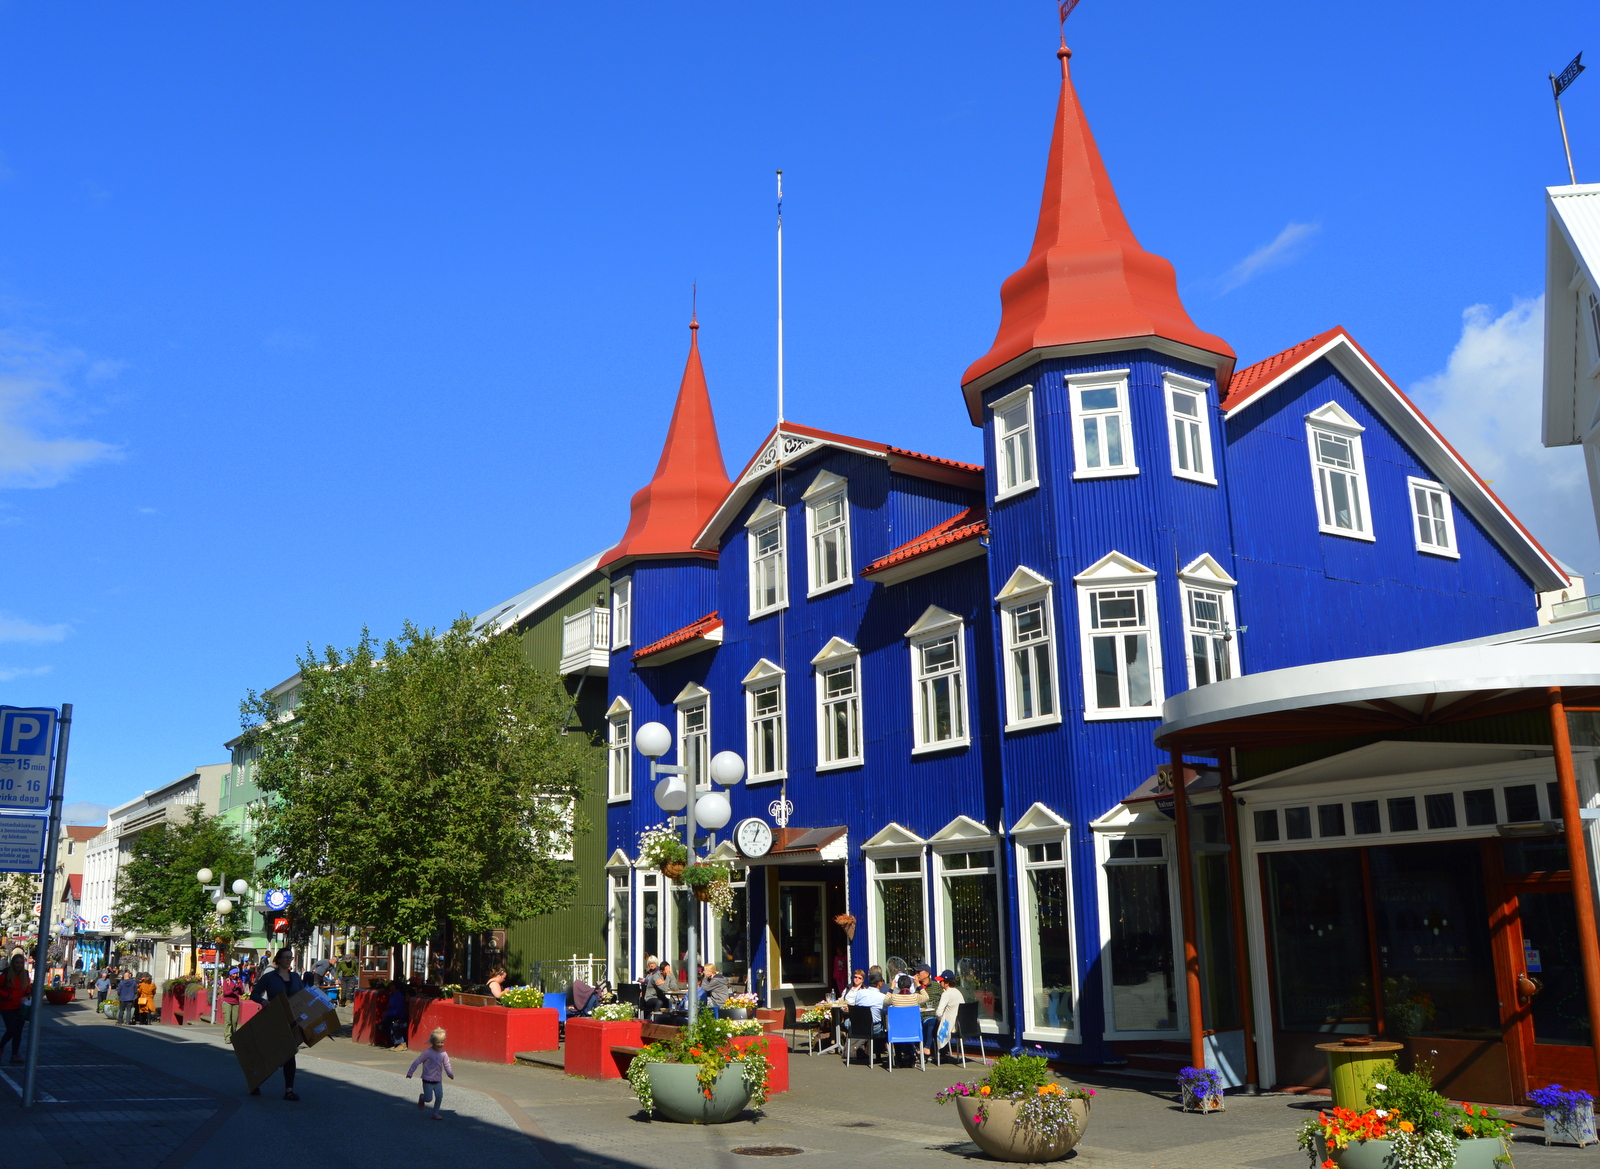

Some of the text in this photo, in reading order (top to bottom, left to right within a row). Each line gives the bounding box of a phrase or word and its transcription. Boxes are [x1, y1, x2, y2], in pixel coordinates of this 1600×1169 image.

[10, 716, 41, 752] P
[16, 758, 31, 770] 15
[0, 778, 14, 791] 10
[26, 779, 41, 792] 16
[19, 793, 40, 804] daga
